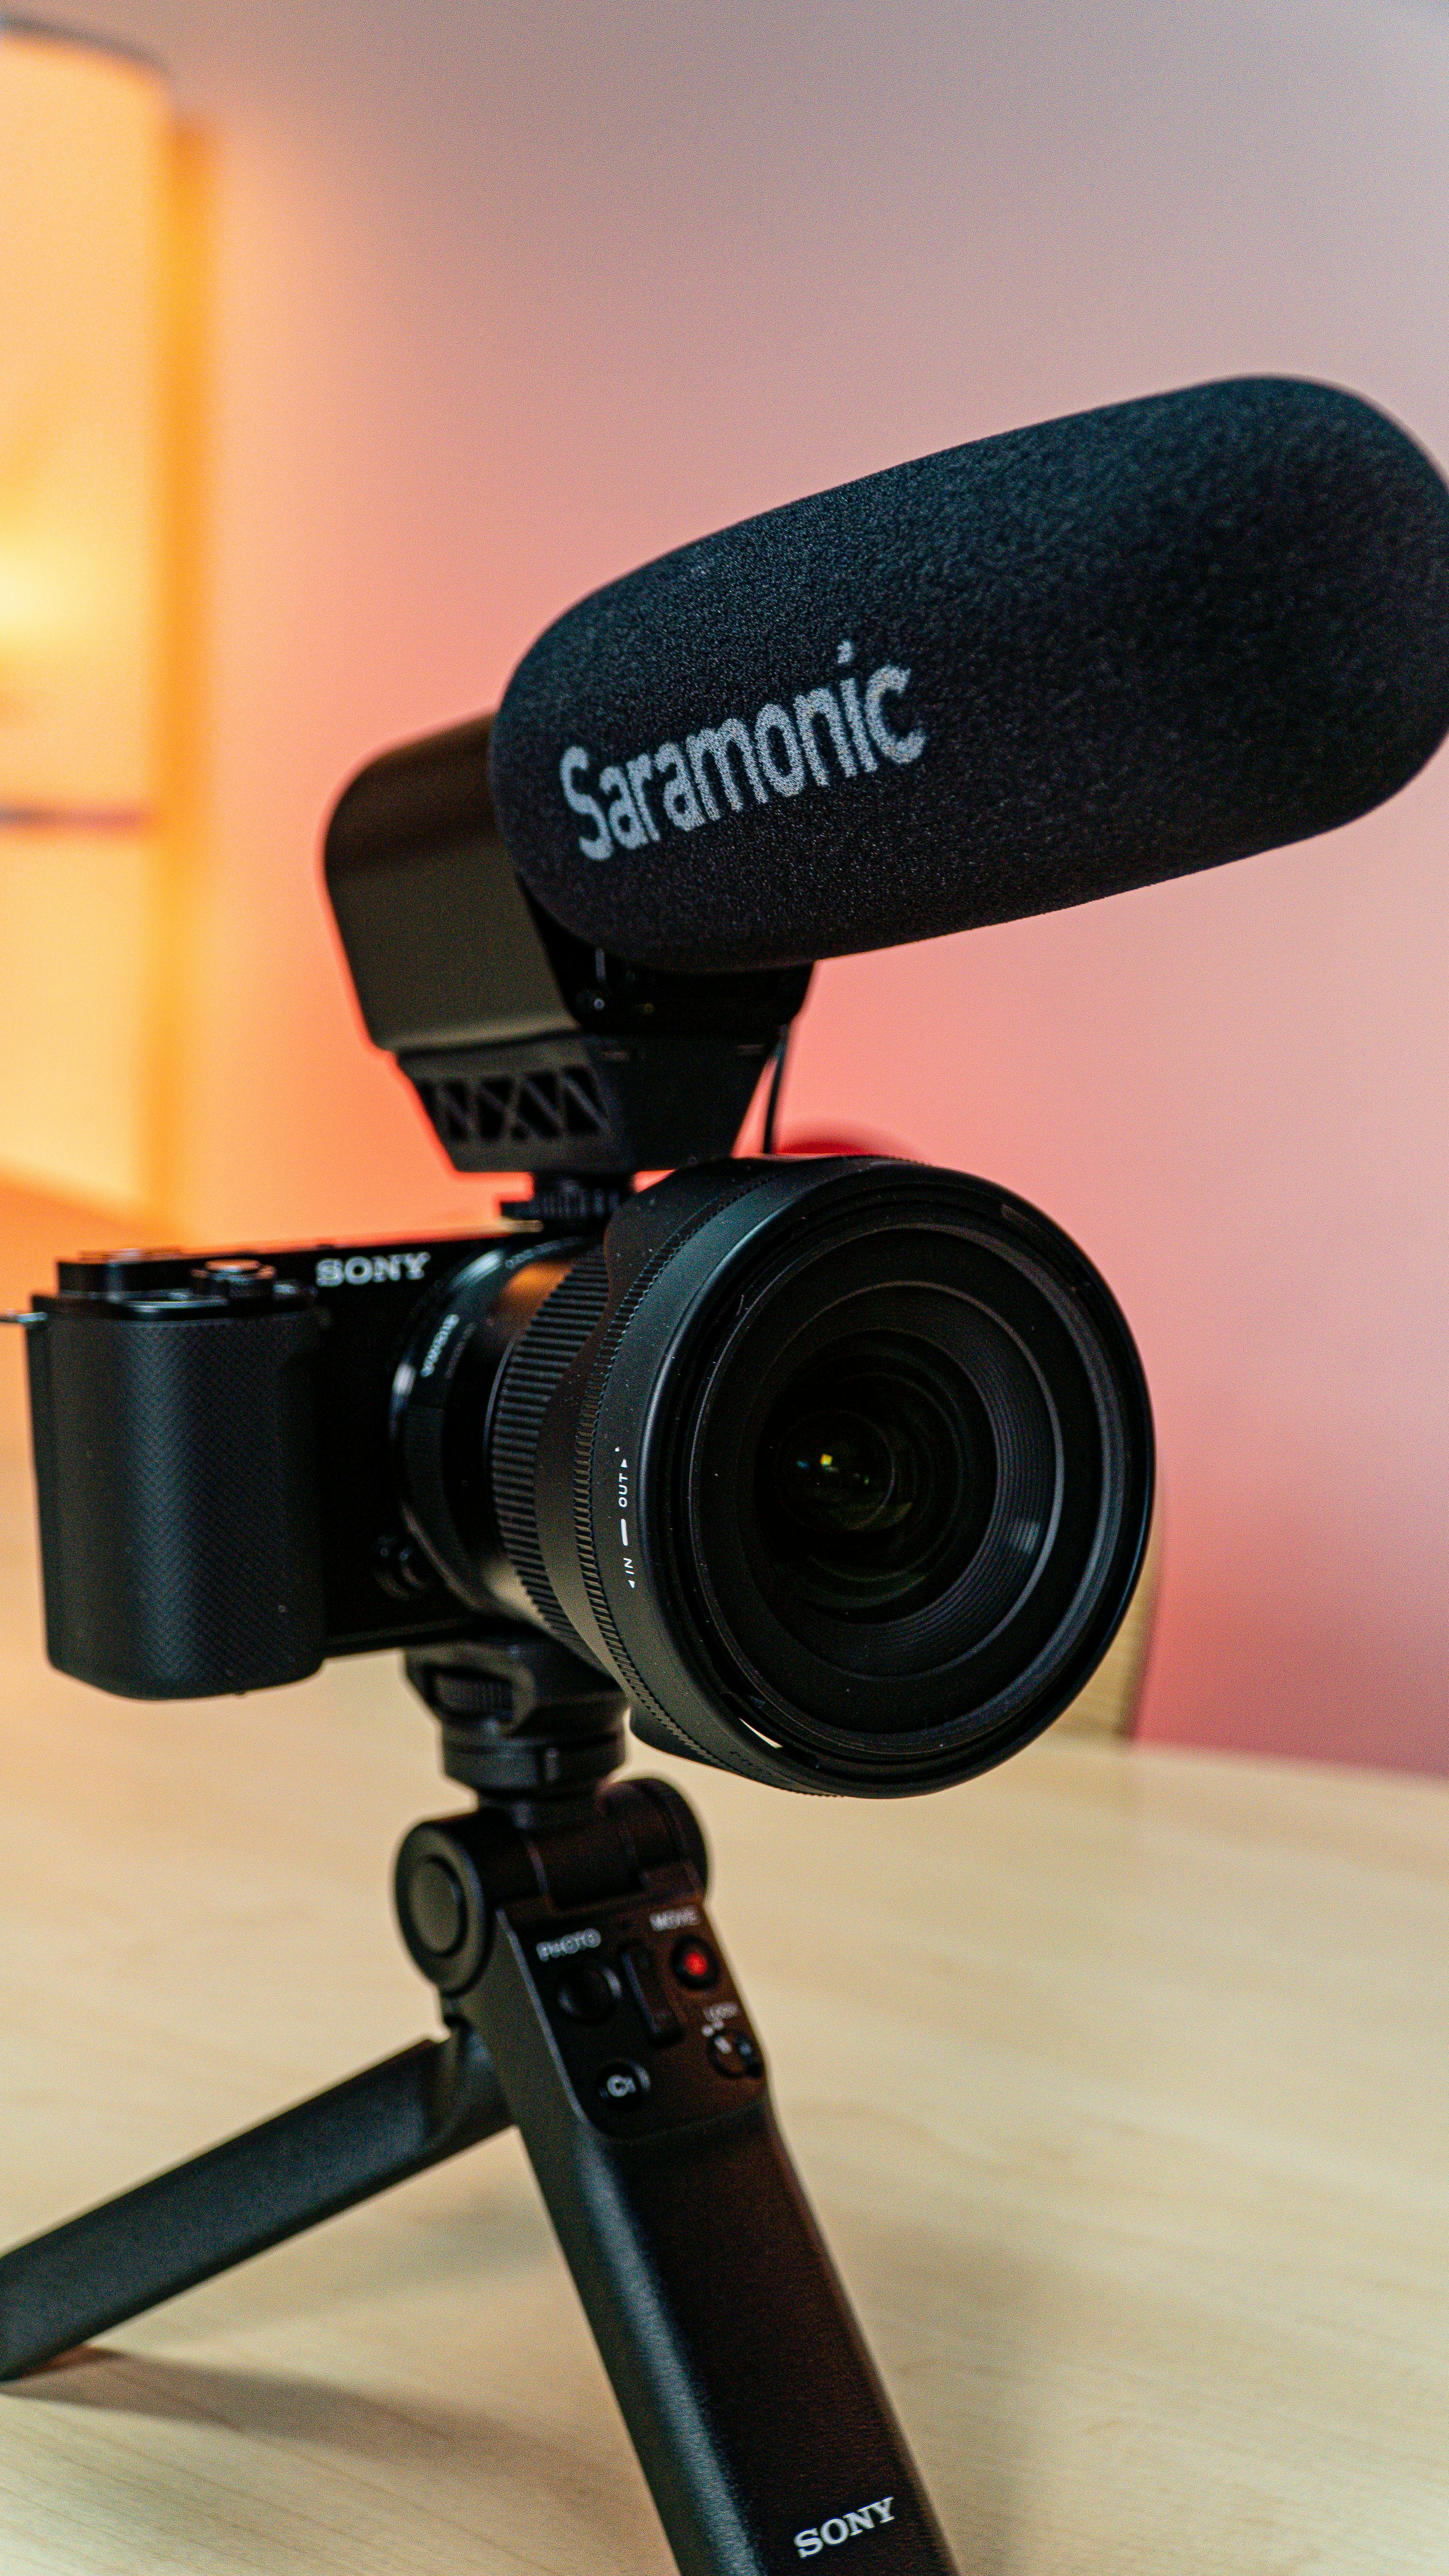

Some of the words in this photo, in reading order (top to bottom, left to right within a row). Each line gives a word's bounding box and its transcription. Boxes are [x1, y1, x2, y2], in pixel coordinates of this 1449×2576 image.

[560, 640, 928, 860] Saramonic
[316, 1252, 430, 1288] SONY
[618, 1473, 627, 1507] OUT
[623, 1558, 634, 1574] IN
[536, 1928, 601, 1961] PHOTO
[794, 2497, 894, 2558] SONY
